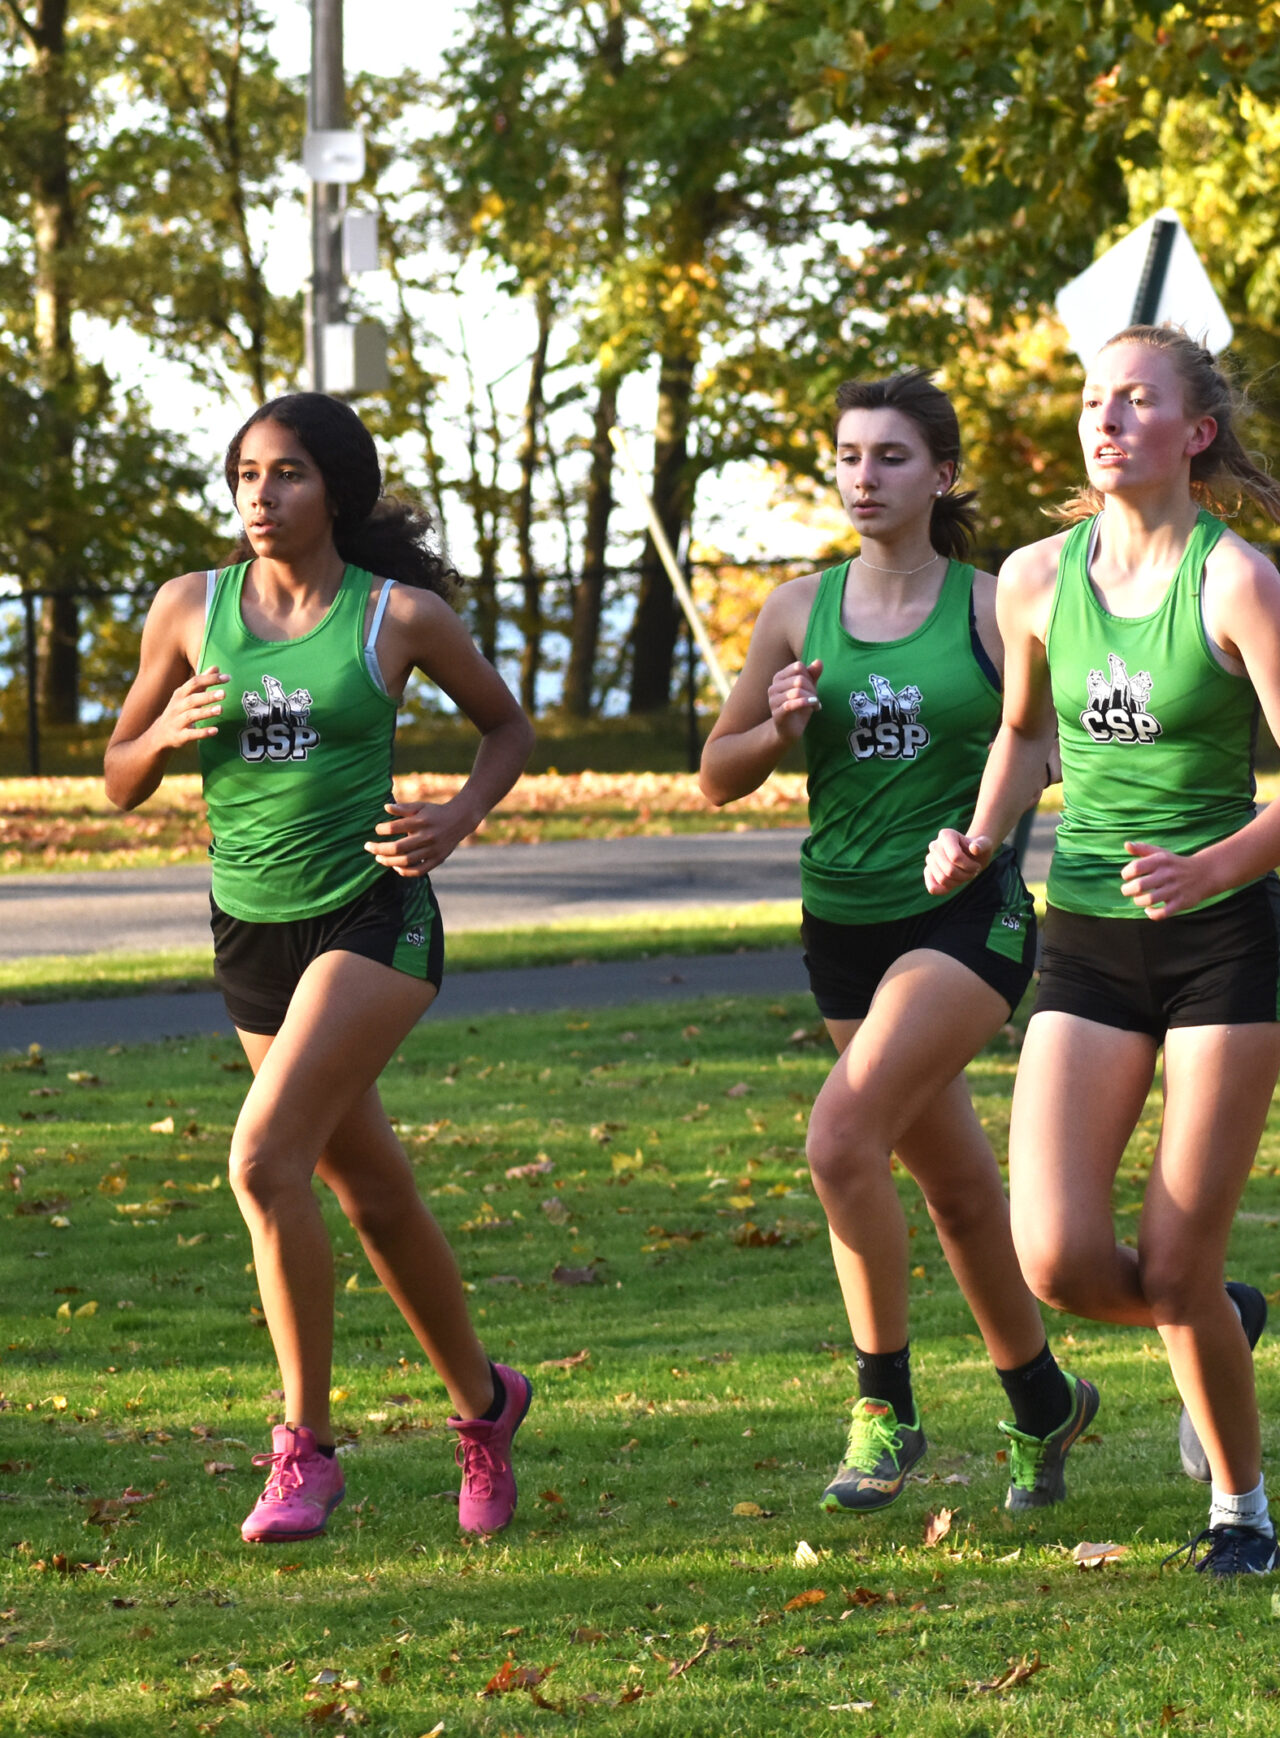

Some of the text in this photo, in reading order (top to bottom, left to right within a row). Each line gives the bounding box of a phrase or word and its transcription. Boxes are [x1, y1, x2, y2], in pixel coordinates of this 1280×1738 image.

[240, 722, 320, 761] CSP
[848, 721, 929, 760] CSP
[1080, 708, 1162, 743] CSP
